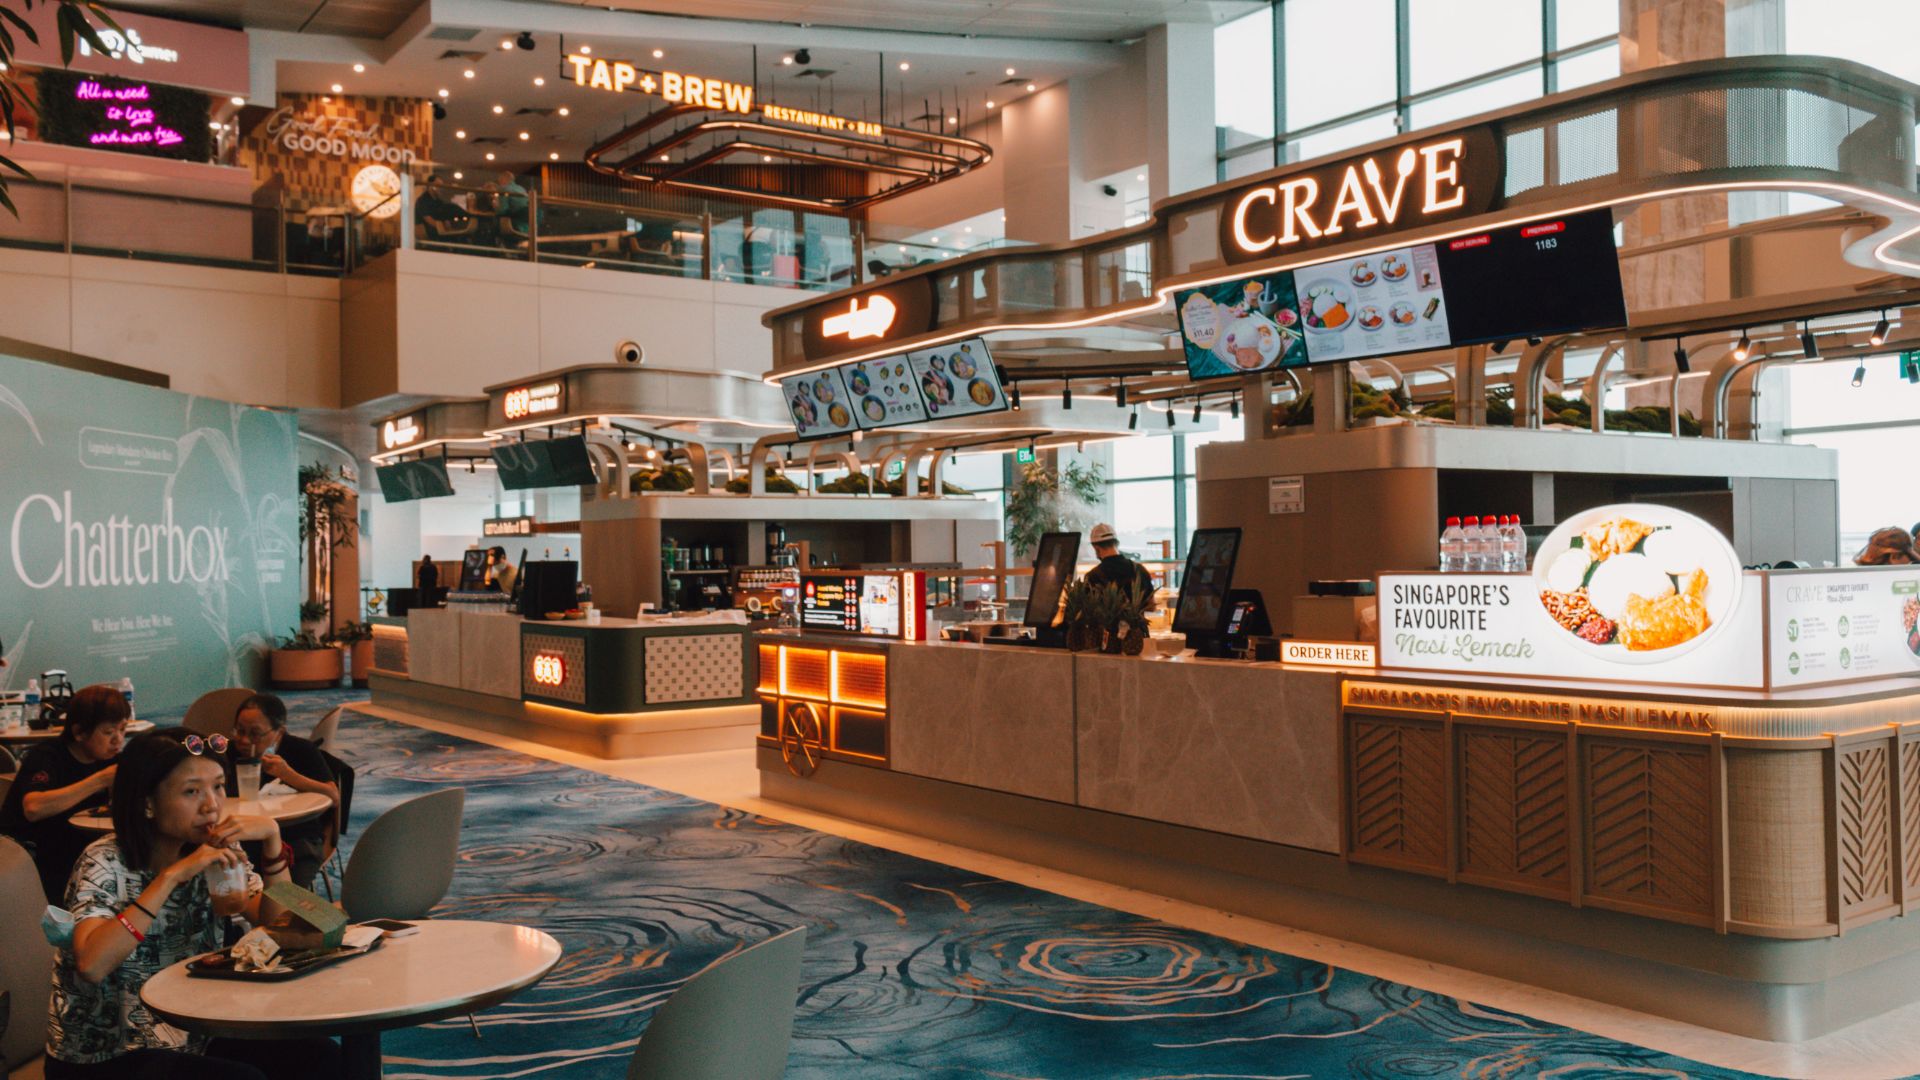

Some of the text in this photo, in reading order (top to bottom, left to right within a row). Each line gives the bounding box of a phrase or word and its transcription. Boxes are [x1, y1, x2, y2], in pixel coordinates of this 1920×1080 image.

[568, 54, 635, 93] TAP
[661, 71, 752, 114] BREW
[266, 106, 325, 144] Good
[764, 104, 845, 130] RESTAURANT
[857, 121, 882, 137] BAR
[283, 132, 416, 164] GOOD MOOD
[1233, 139, 1465, 252] CRAVE
[1535, 237, 1558, 250] 1183
[10, 489, 230, 590] Chatterbox
[1393, 584, 1511, 606] SINGAPORE'S
[1395, 608, 1487, 631] FAVOURITE
[1289, 646, 1369, 661] ORDER HERE
[1395, 633, 1535, 662] Nasi Lemak
[1578, 703, 1627, 722] NASI
[1633, 707, 1713, 730] LEMAK
